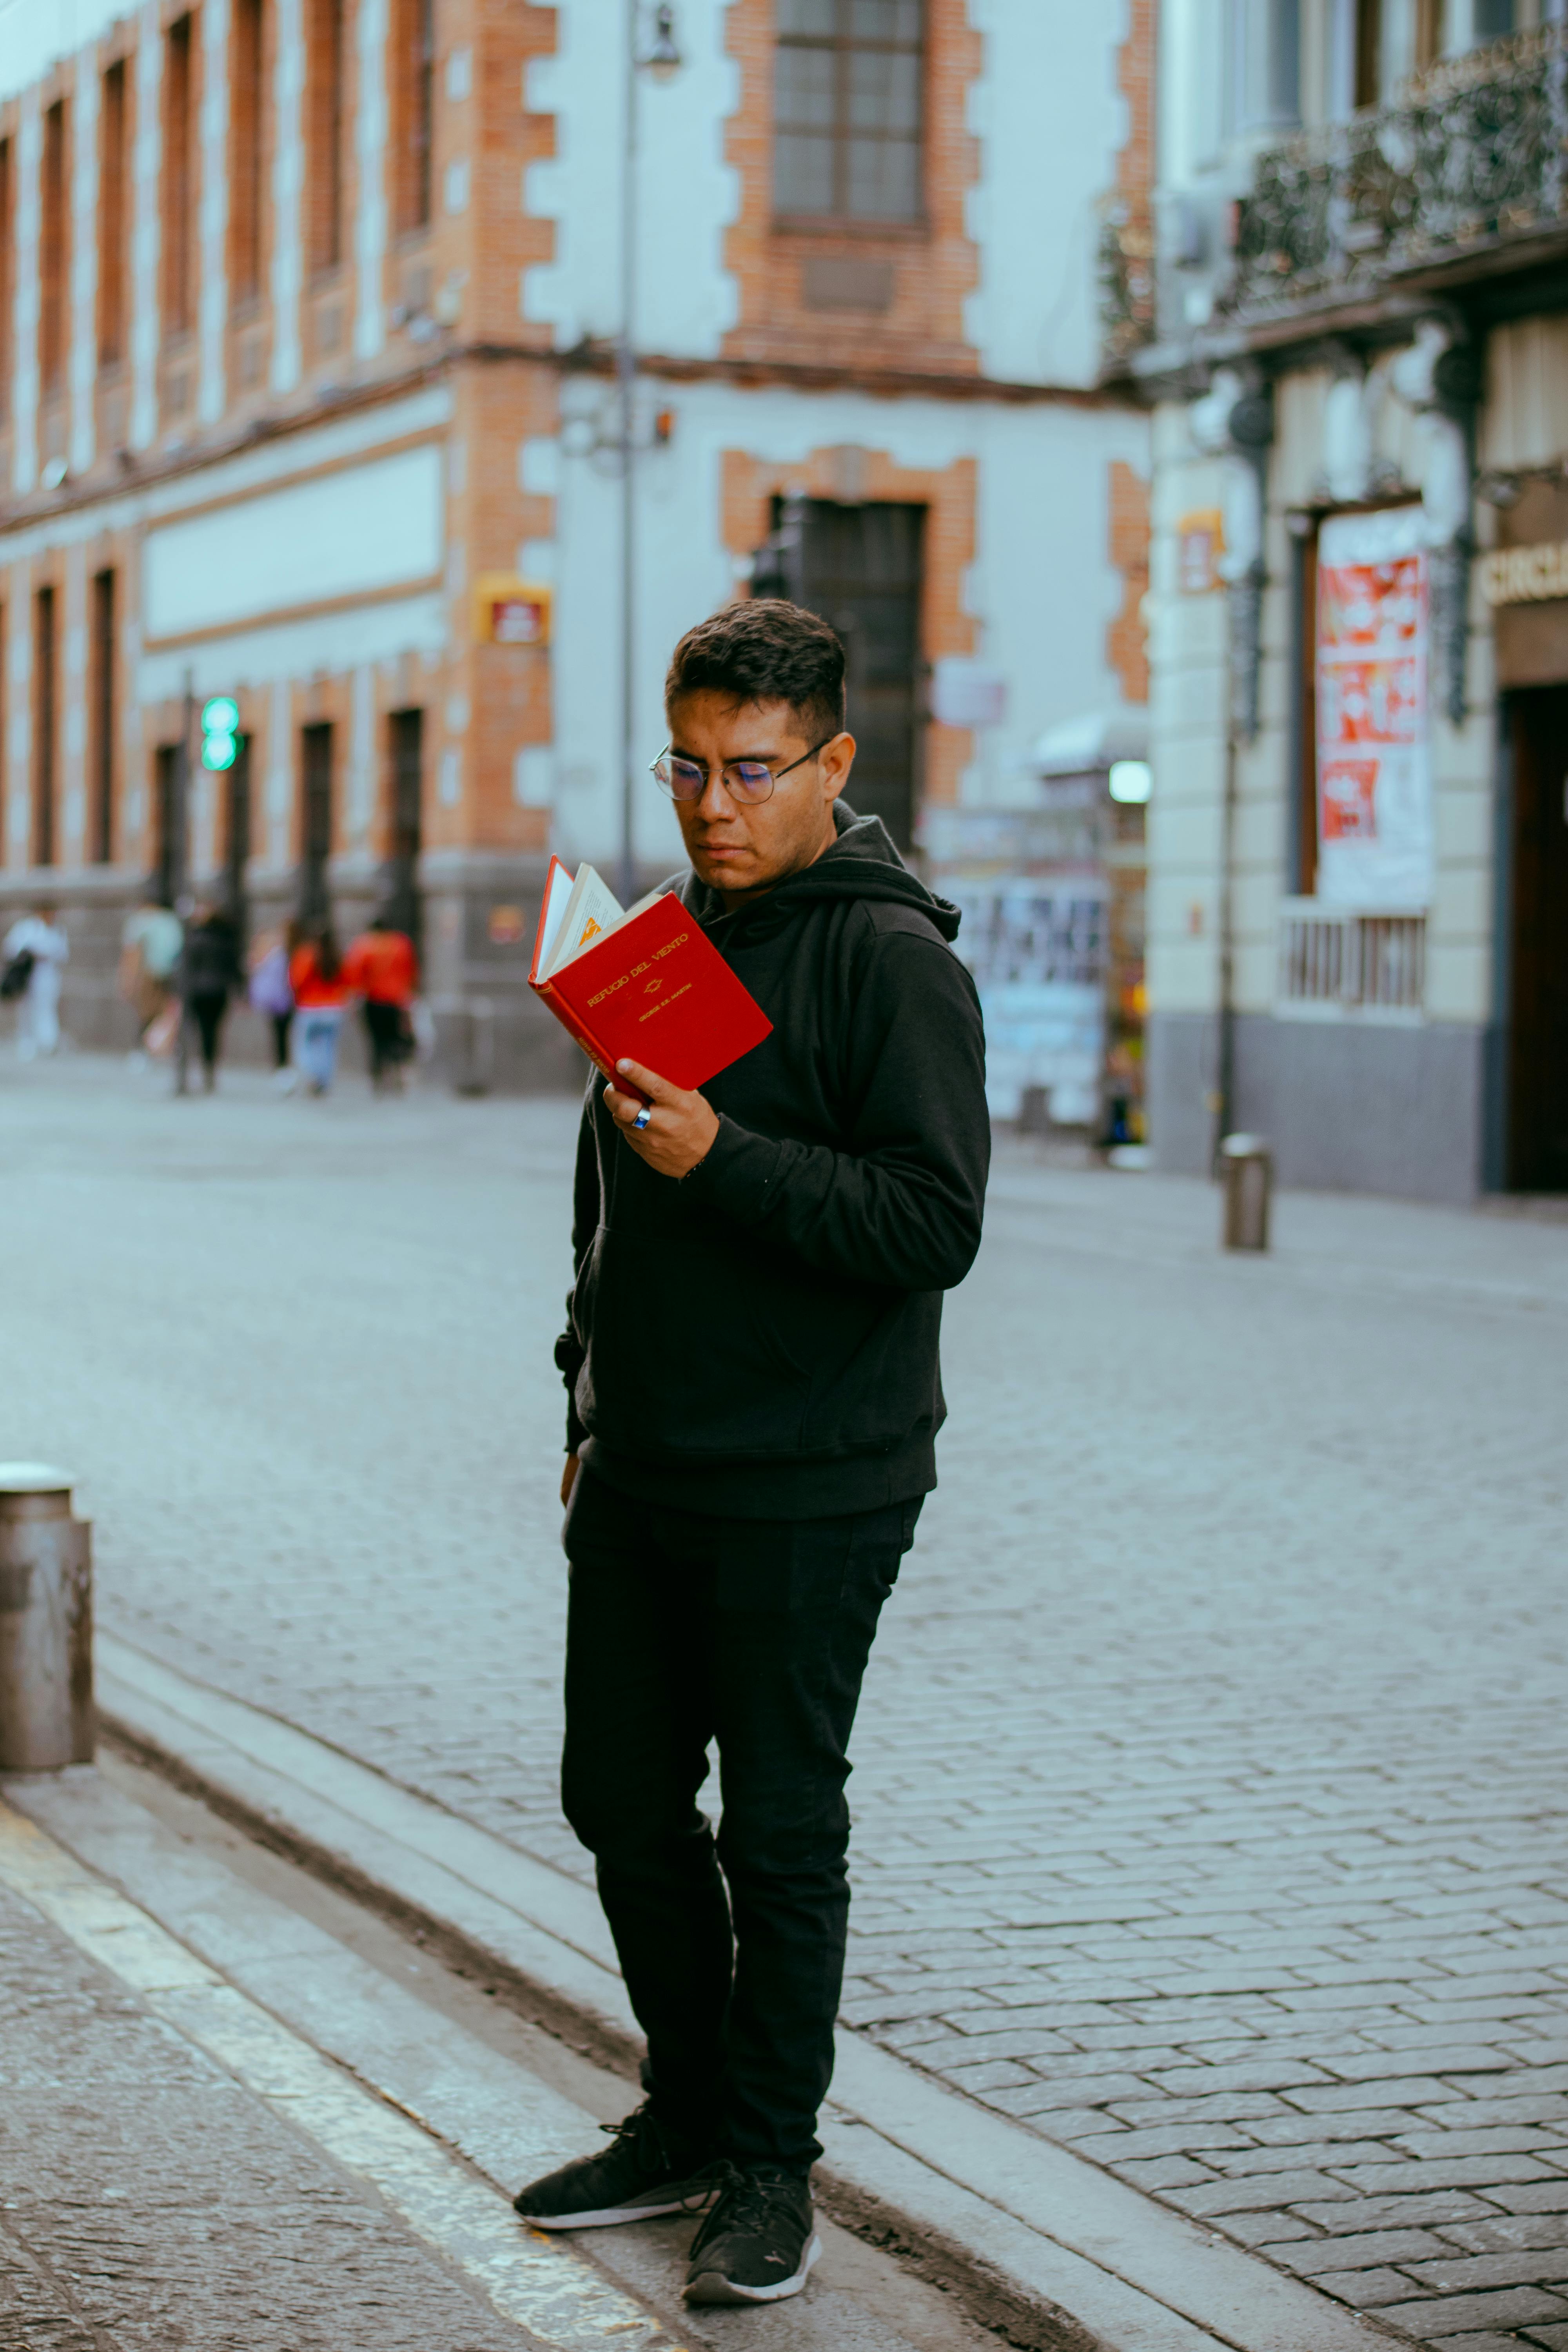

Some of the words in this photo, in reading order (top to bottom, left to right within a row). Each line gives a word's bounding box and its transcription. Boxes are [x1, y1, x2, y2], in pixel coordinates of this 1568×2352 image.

[587, 975, 629, 1007] REFUGIO
[630, 962, 652, 977] DEL
[652, 933, 688, 960] VIENTO
[639, 1005, 661, 1022] GEORGE
[671, 983, 692, 1000] MARTIN
